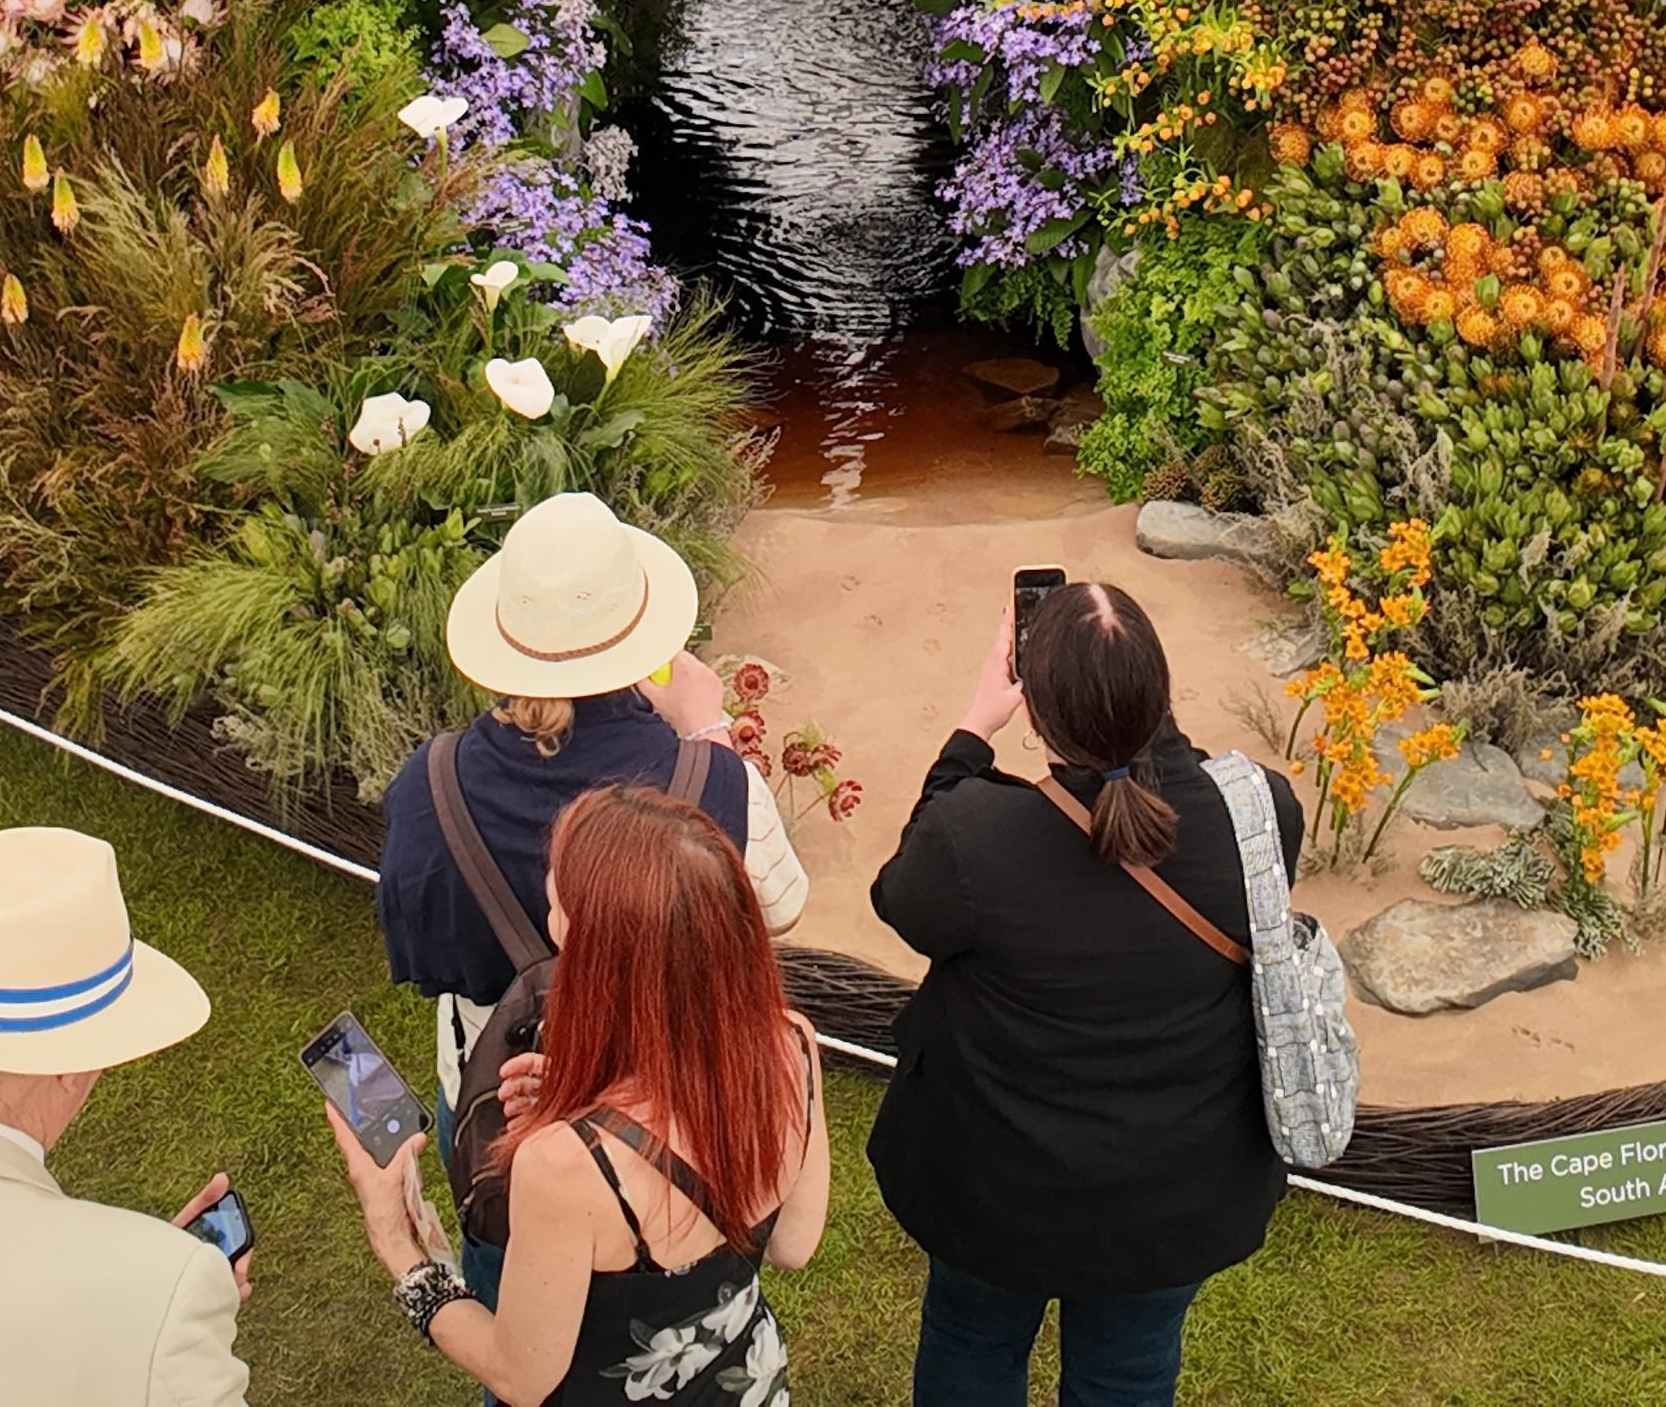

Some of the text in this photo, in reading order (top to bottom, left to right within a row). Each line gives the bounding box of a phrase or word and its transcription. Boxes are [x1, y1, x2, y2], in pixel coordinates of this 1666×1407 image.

[1496, 1161, 1544, 1187] The
[1550, 1150, 1614, 1178] Cape
[1579, 1178, 1651, 1209] South
